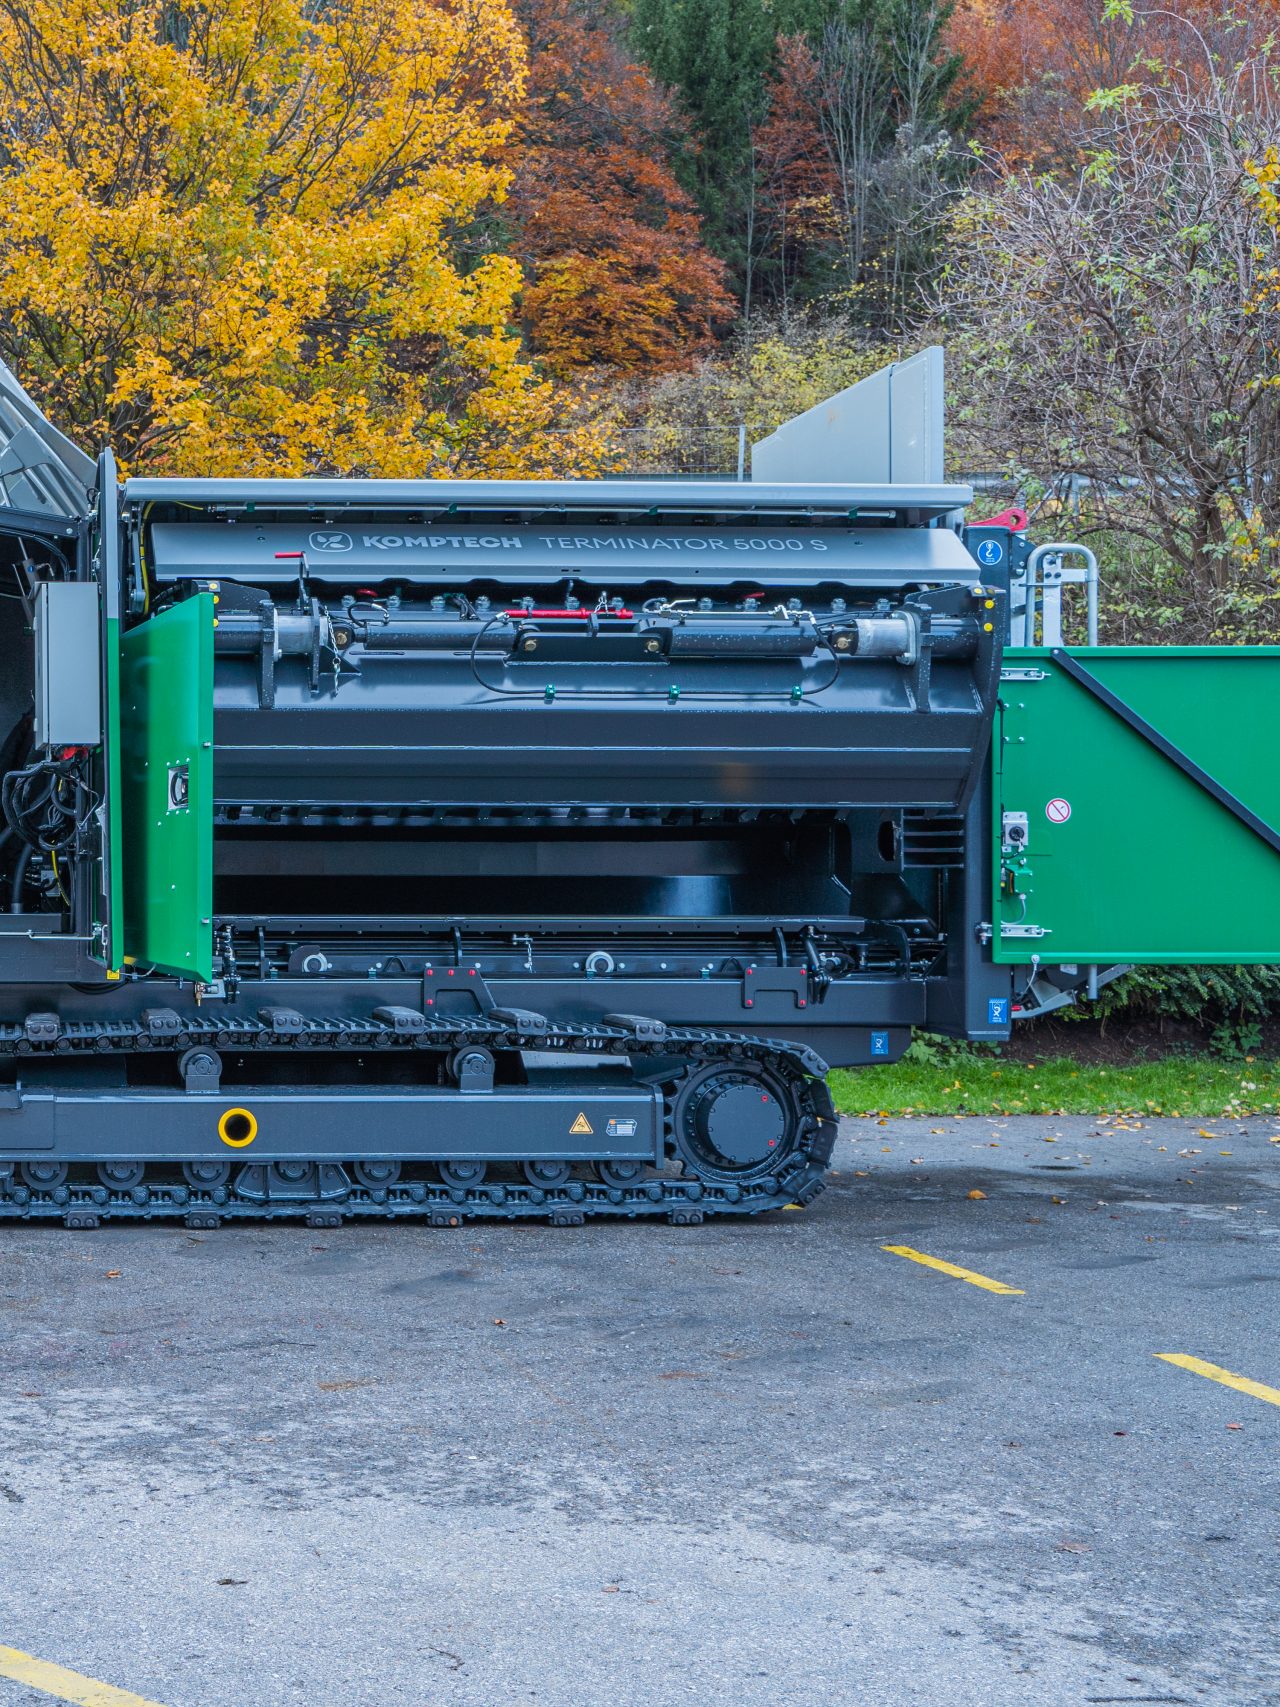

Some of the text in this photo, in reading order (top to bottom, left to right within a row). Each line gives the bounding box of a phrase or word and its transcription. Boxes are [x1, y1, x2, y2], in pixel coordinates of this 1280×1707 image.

[362, 535, 828, 551] KOMPTECH TERMINATOR 5000 S
